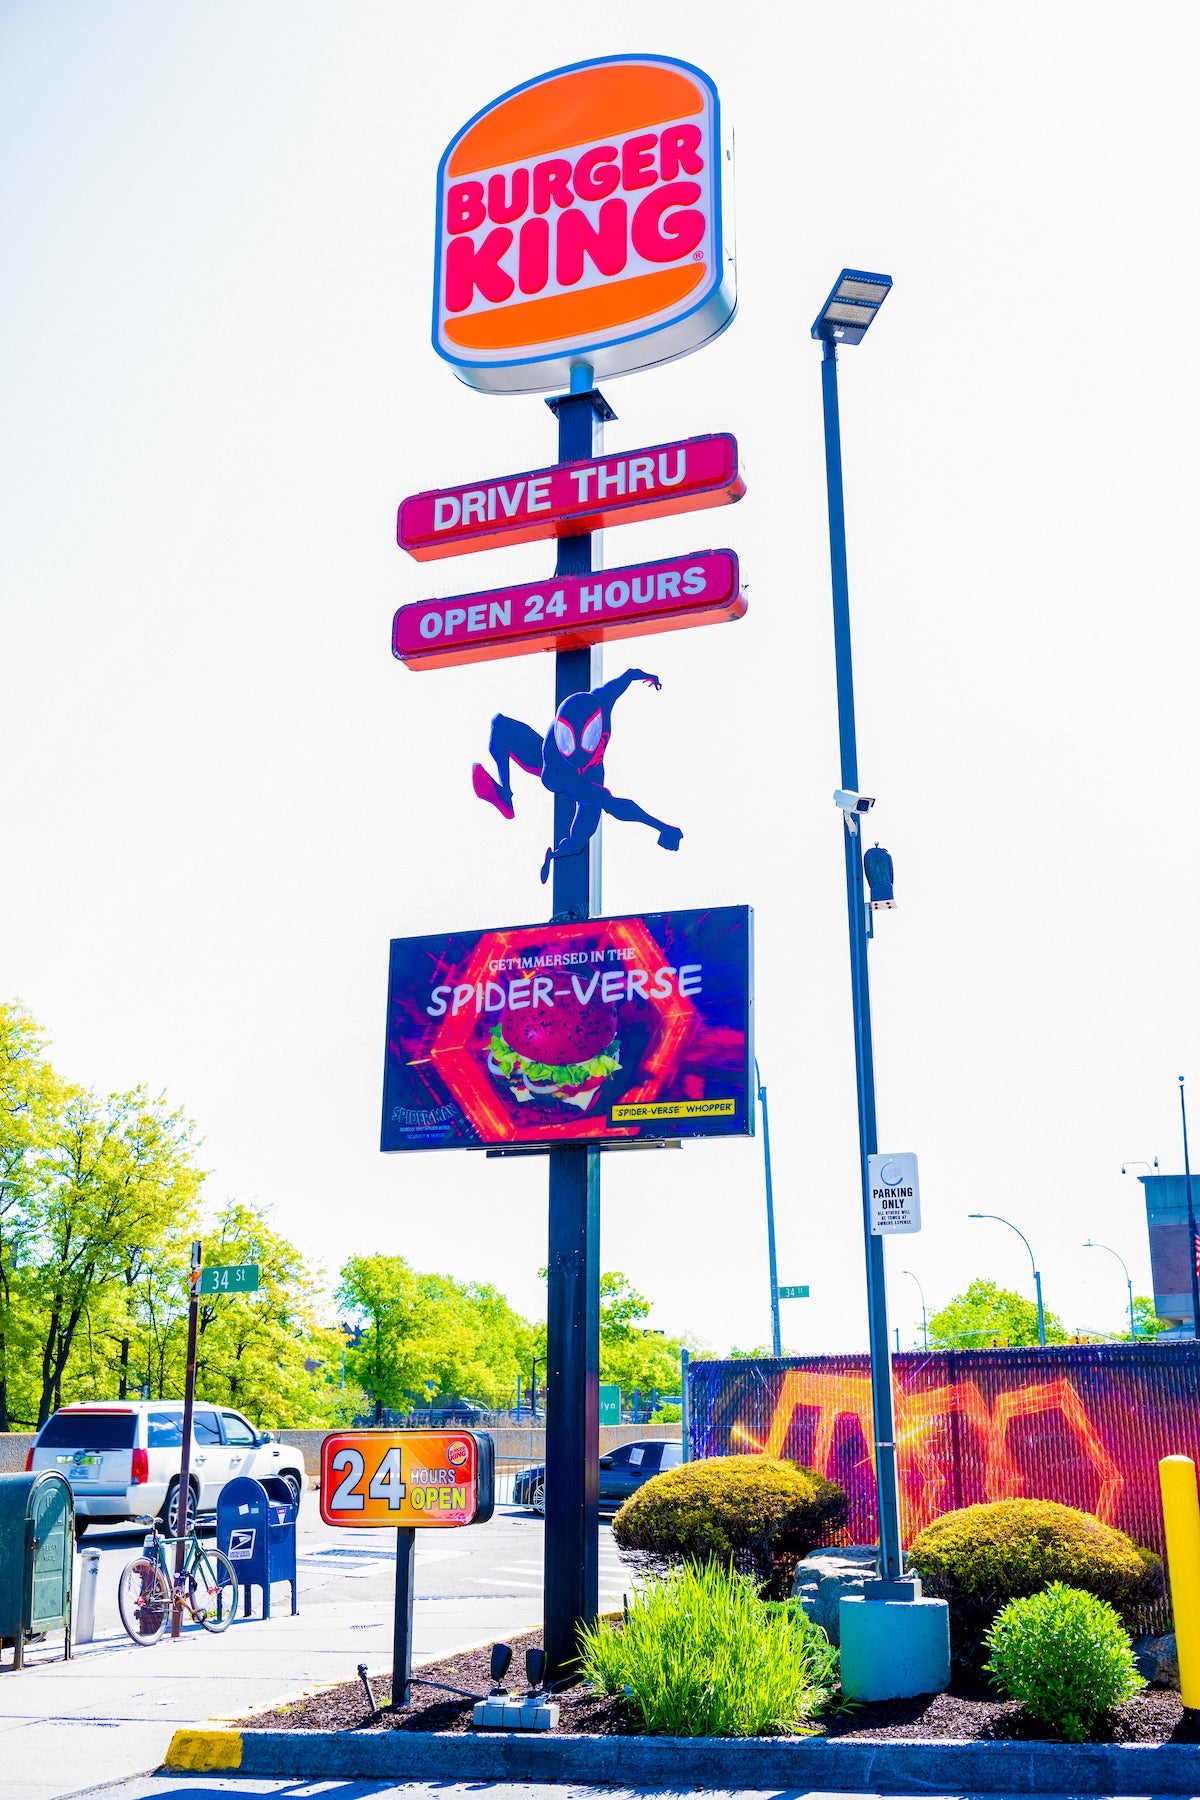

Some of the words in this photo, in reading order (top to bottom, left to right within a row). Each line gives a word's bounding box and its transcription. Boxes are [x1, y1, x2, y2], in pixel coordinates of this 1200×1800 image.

[447, 123, 704, 235] BURGER
[445, 181, 706, 312] KING
[434, 476, 552, 531] DRIVE
[570, 449, 686, 503] THRU
[419, 600, 511, 639] OPEN
[523, 590, 567, 623] 24
[579, 566, 707, 613] HOURS
[488, 958, 515, 972] GET
[517, 951, 588, 970] IMMERSED
[590, 950, 605, 963] IN
[607, 947, 636, 962] THE
[426, 964, 703, 1017] SPIDER-VERSE
[873, 1187, 913, 1198] PARKING
[882, 1199, 905, 1209] ONLY
[212, 1270, 229, 1290] 34
[235, 1268, 246, 1282] St
[785, 1287, 795, 1298] 34
[329, 1447, 407, 1511] 24
[409, 1468, 457, 1485] HOURS
[410, 1486, 467, 1511] OPEN
